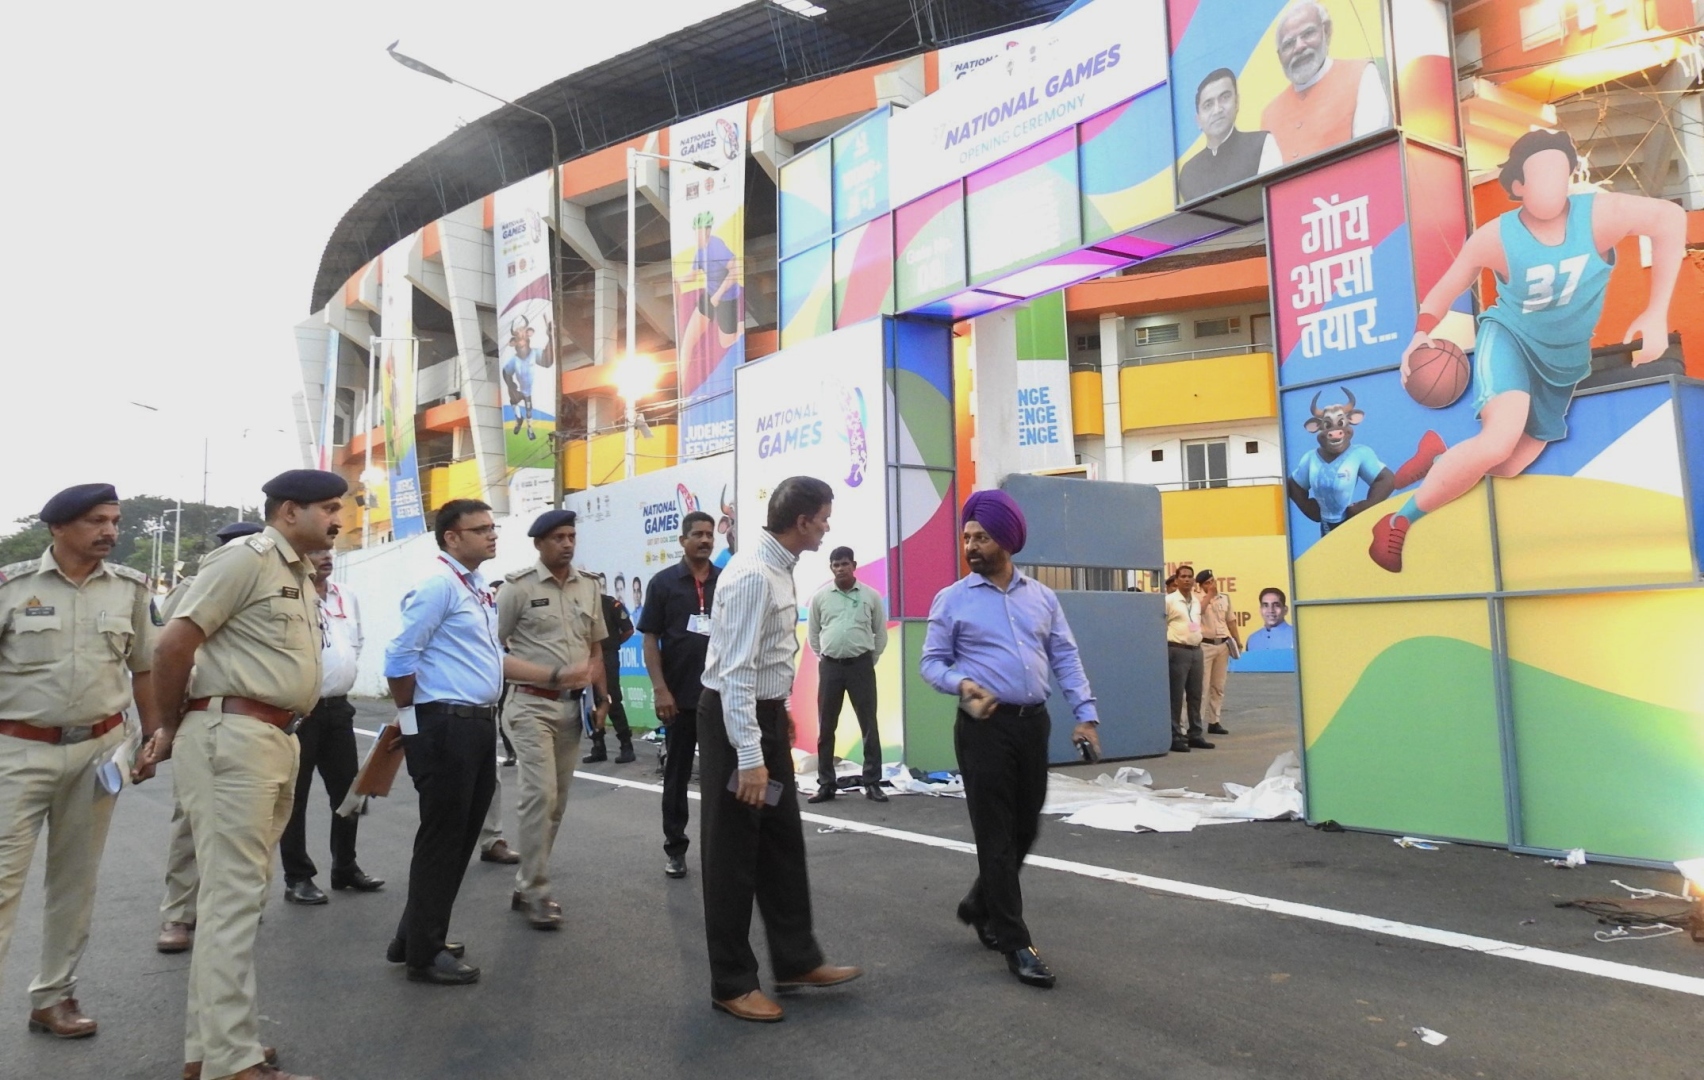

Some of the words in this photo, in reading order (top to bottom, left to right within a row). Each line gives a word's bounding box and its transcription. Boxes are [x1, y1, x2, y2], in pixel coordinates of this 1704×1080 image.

[944, 86, 1040, 150] NATIONAL
[1045, 43, 1122, 98] GAMES
[680, 130, 715, 146] NATIONAL
[959, 130, 1010, 164] OPENING
[1012, 93, 1086, 138] CEREMONY
[681, 137, 717, 157] GAMES
[502, 223, 526, 239] GAMES
[1301, 193, 1370, 254] गोंय
[1290, 245, 1374, 310] आसा
[1522, 253, 1590, 314] 37
[1018, 386, 1050, 406] NGE
[756, 402, 818, 433] NATIONAL
[1018, 405, 1057, 425] ENGE
[758, 420, 823, 459] GAMES
[1019, 425, 1058, 446] ENGE
[643, 500, 677, 517] NATIONAL
[644, 513, 680, 534] GAMES
[1216, 577, 1237, 592] TE
[1234, 611, 1251, 627] IP
[618, 647, 640, 668] TION.
